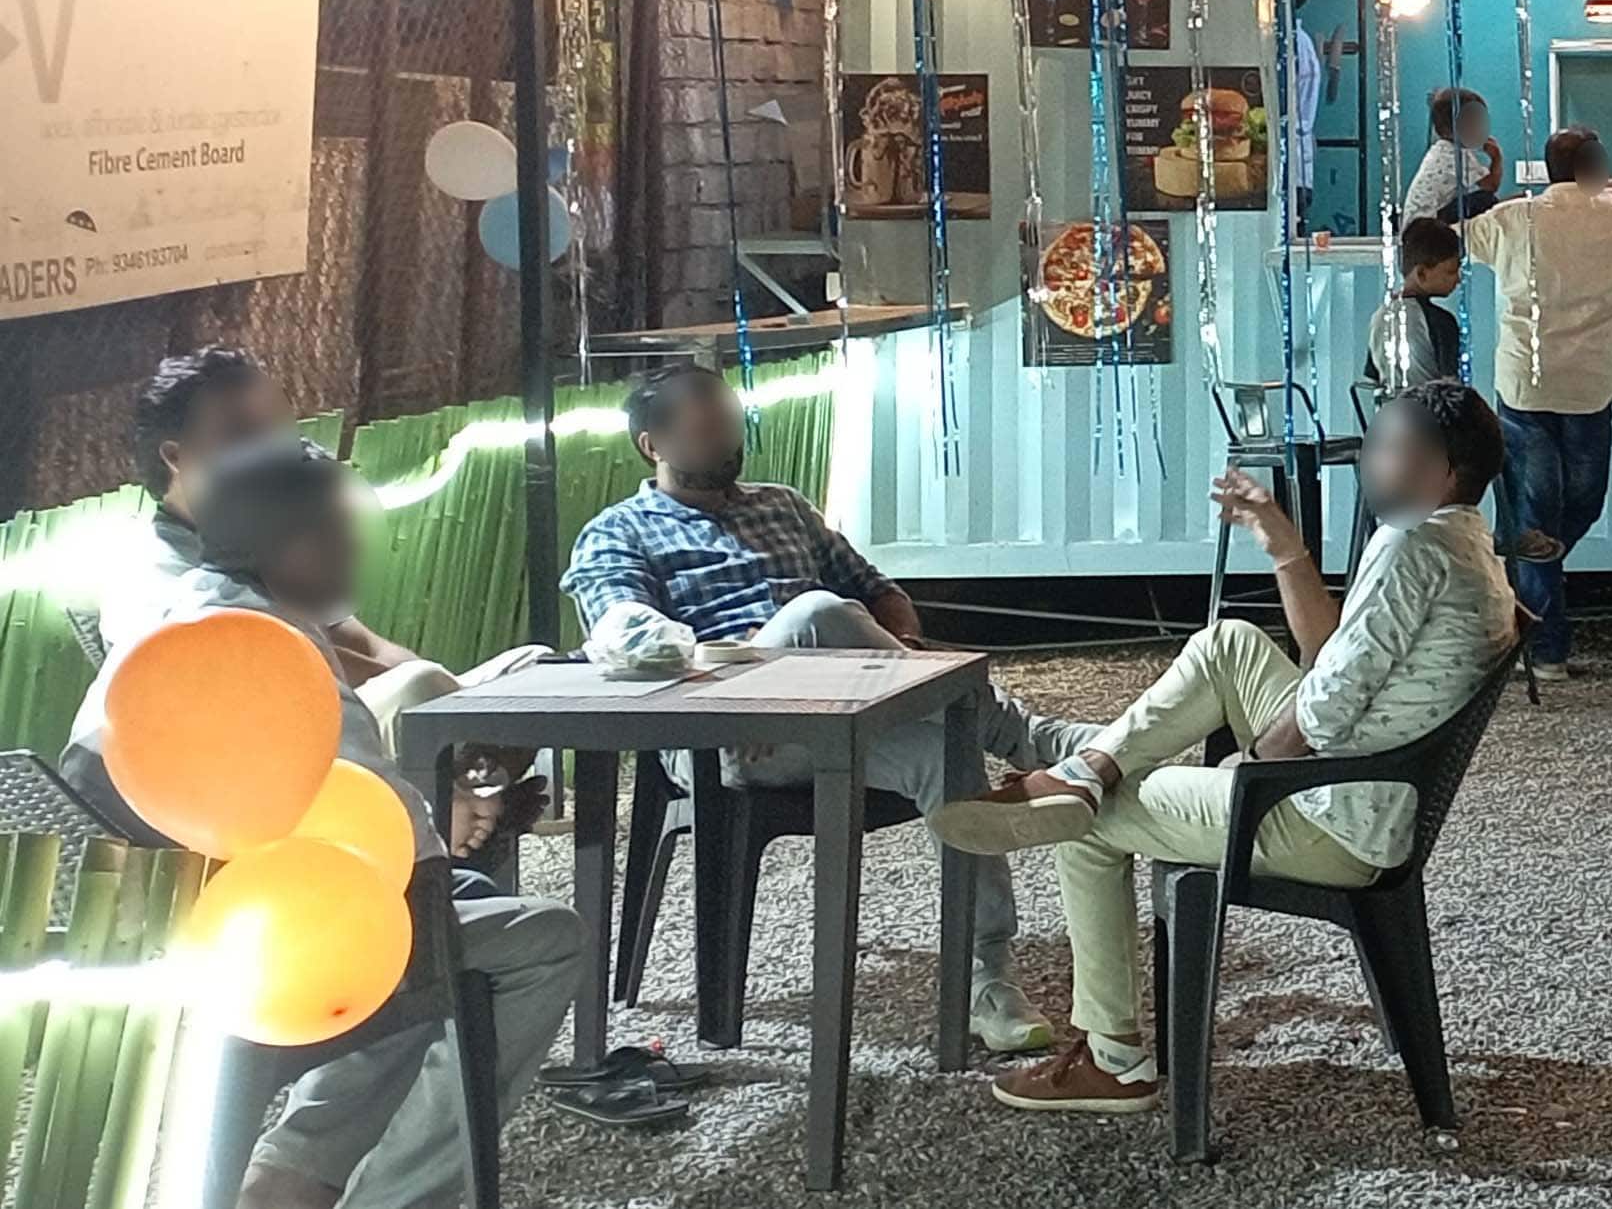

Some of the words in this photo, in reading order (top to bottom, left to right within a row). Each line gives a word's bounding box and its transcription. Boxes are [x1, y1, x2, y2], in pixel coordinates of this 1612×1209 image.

[88, 150, 131, 176] Fibre
[136, 145, 197, 171] Cement
[200, 139, 245, 167] Board
